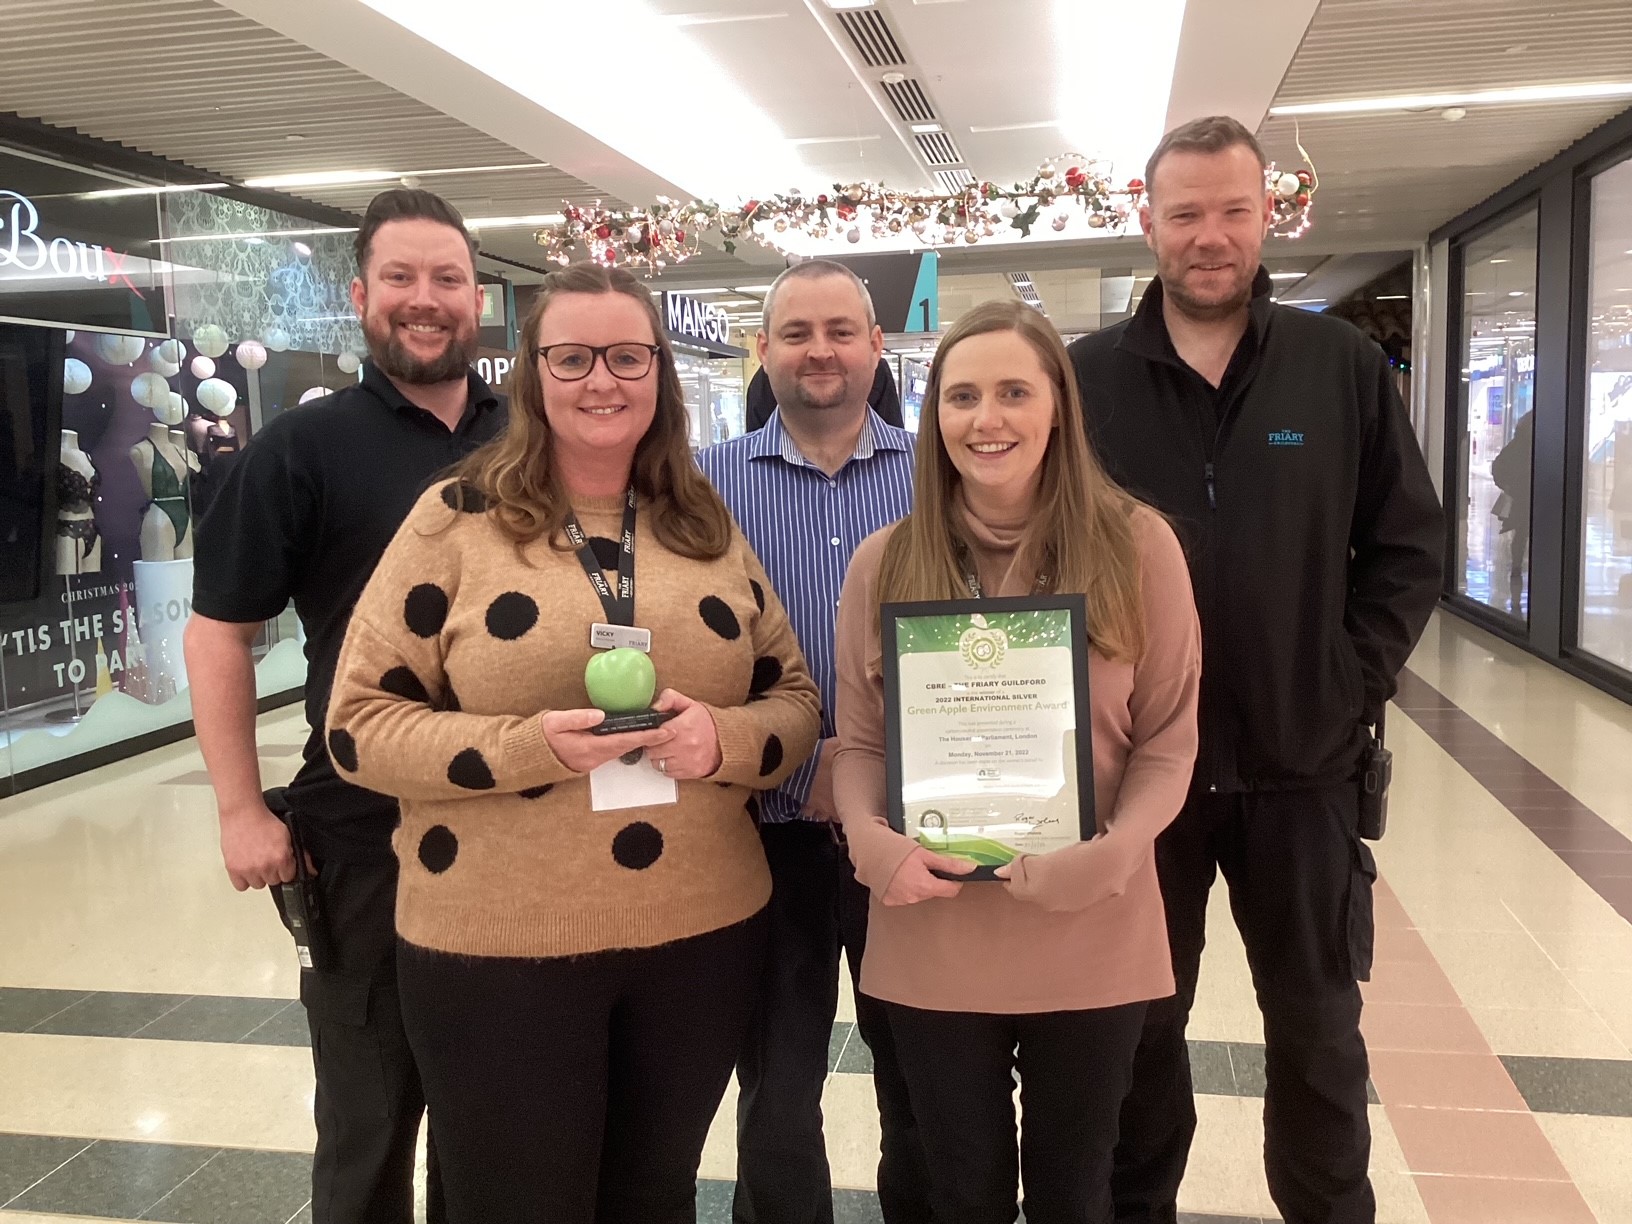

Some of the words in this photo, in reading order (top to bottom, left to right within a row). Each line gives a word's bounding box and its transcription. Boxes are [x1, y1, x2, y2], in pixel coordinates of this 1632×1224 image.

[0, 190, 146, 300] Boux
[667, 291, 729, 344] MANGO
[919, 298, 929, 332] 1
[477, 357, 516, 385] OP
[1268, 433, 1304, 441] FRIARY
[568, 524, 583, 545] FRIAR
[624, 529, 632, 553] FRIARY
[61, 583, 120, 603] CHRISTMAS
[592, 572, 609, 596] FRIARY
[622, 575, 630, 598] FRIARY
[60, 613, 103, 645] THE
[112, 597, 192, 633] SESON
[53, 659, 86, 688] TO
[1001, 679, 1046, 687] GUILDFORD
[907, 706, 937, 715] Green
[939, 705, 968, 715] Apple
[970, 703, 1032, 712] Environment
[953, 694, 1010, 702] INTERNATIONAL
